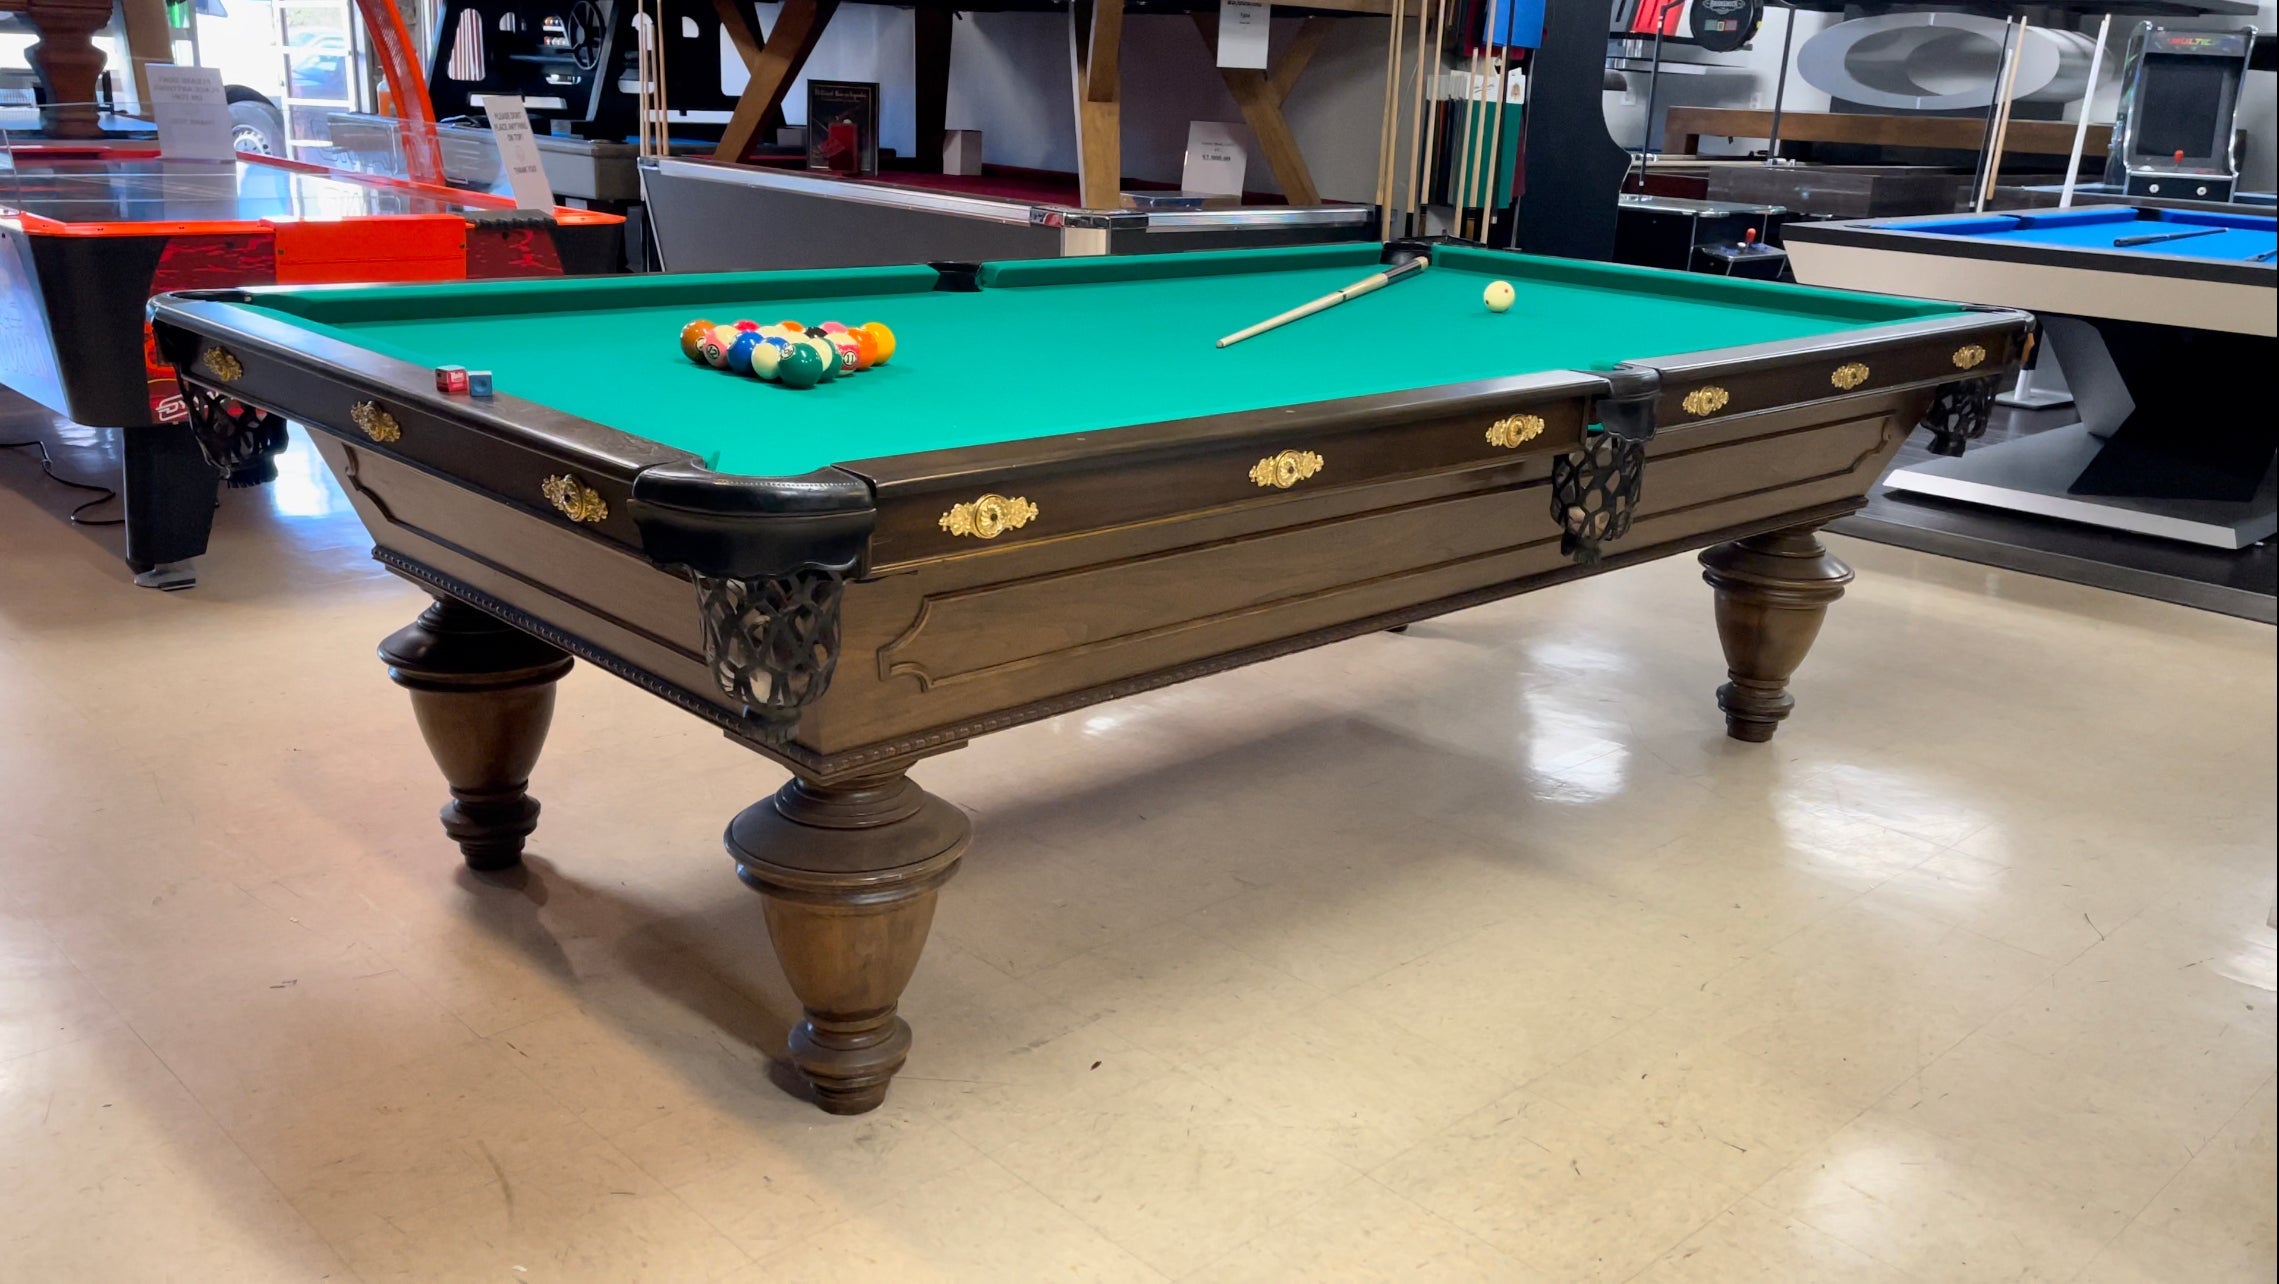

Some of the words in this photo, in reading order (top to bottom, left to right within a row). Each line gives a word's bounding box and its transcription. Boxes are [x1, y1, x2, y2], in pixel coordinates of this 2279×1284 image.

[494, 112, 510, 120] PLEASE
[494, 122, 509, 131] PLACE
[846, 354, 854, 363] 11
